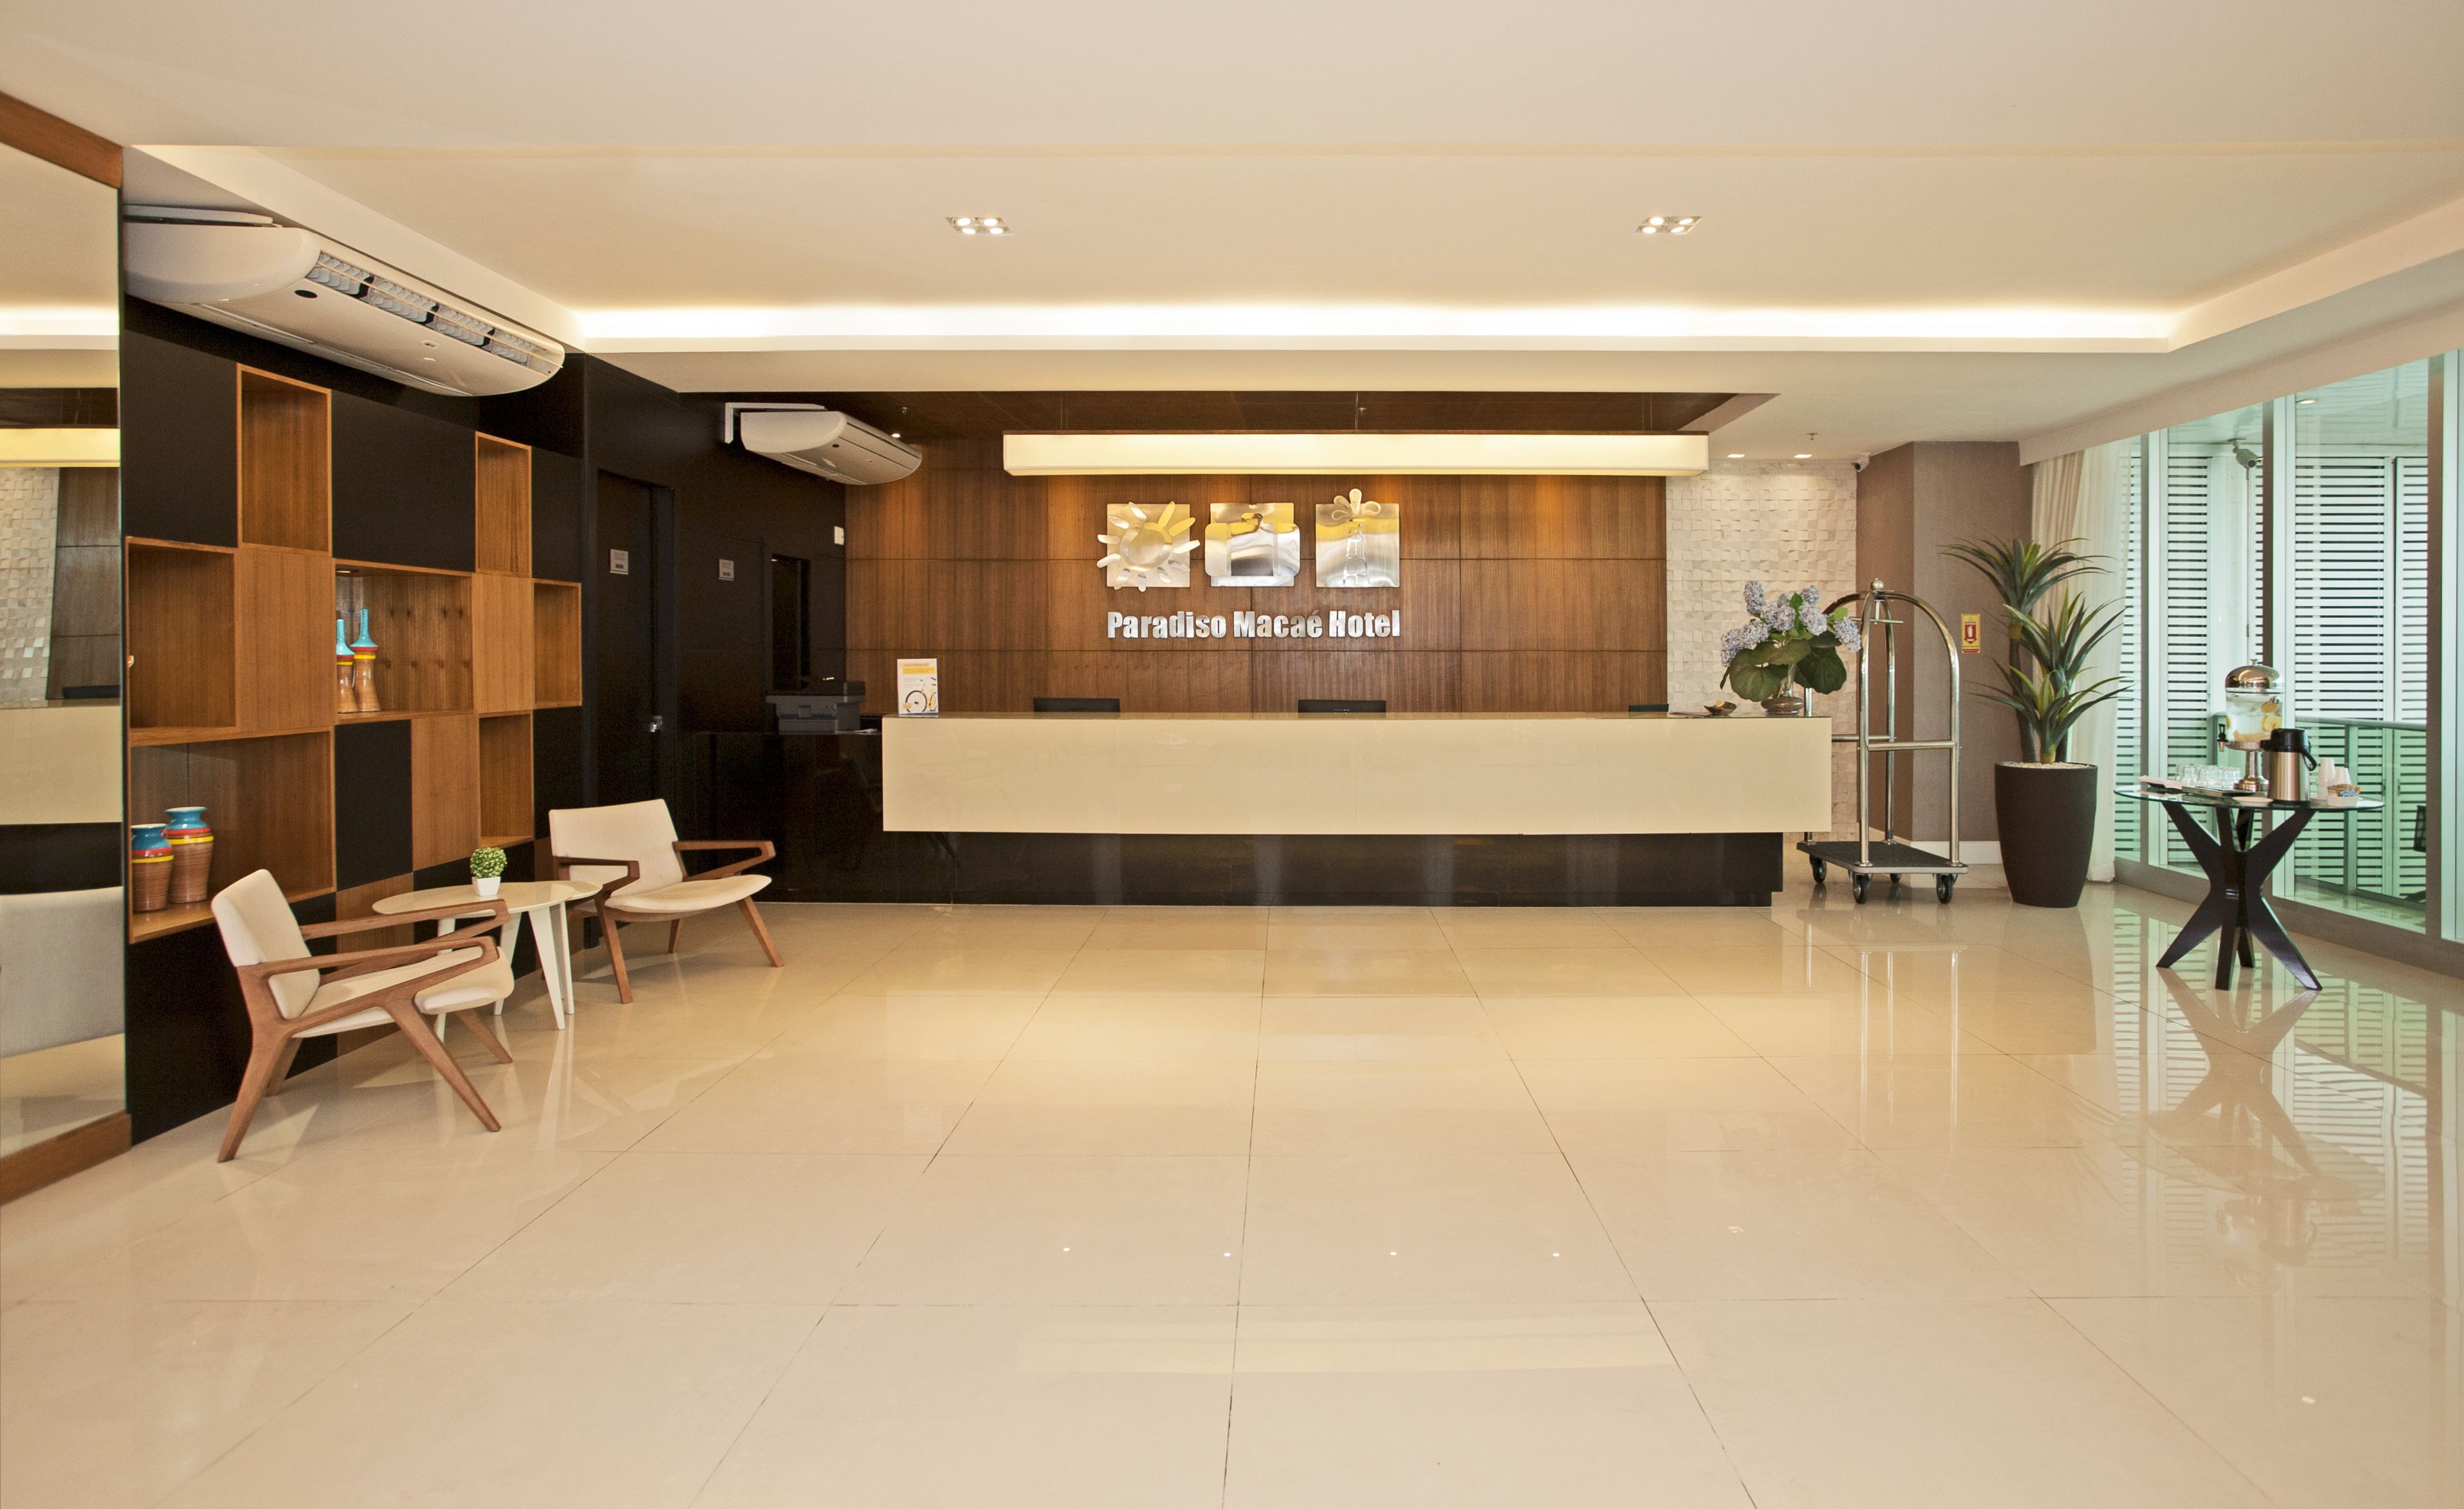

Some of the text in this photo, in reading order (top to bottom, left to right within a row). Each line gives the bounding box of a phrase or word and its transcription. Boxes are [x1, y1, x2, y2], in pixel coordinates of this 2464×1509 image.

[1107, 610, 1400, 638] Paradiso Macaé Hotel
